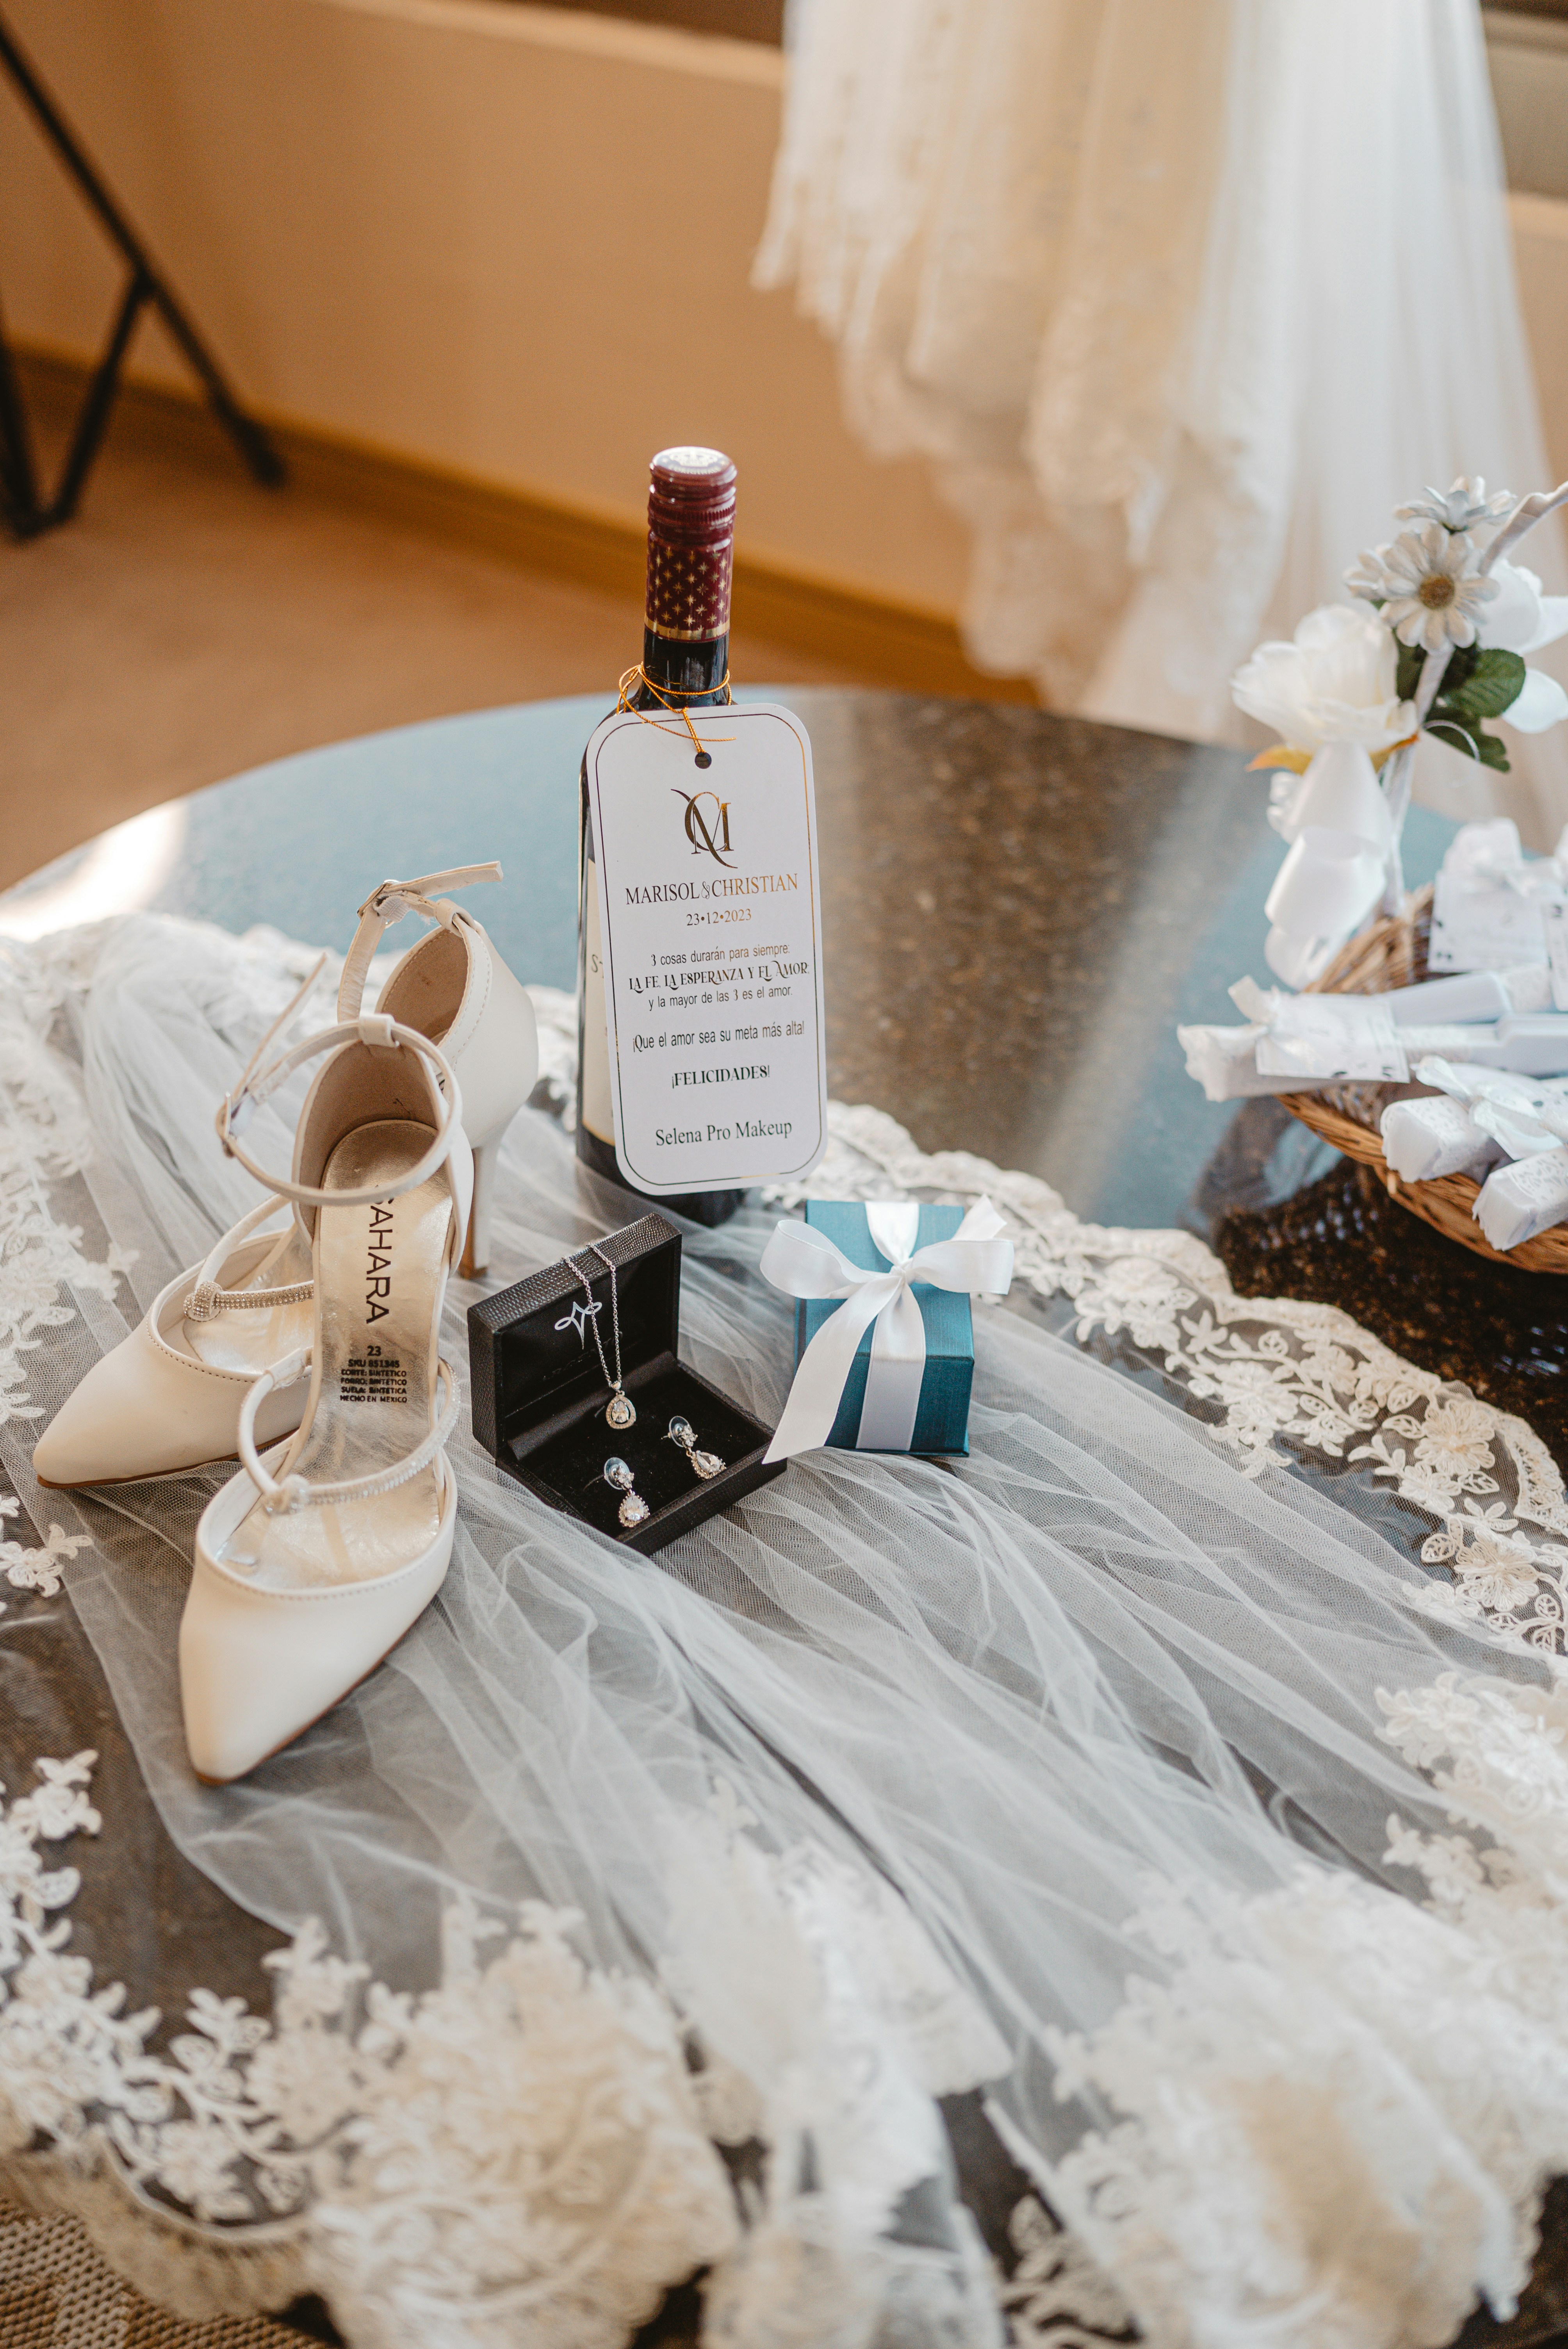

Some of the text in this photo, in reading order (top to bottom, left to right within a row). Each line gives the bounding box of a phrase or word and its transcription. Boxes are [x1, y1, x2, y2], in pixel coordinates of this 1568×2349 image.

[651, 943, 790, 966] 3 cosas durarán para siempre:
[629, 977, 645, 994] LA
[664, 975, 679, 991] LA
[681, 968, 744, 985] ESPERANZA
[748, 967, 754, 978] Y
[758, 966, 772, 982] EL
[649, 985, 793, 1011] y la mayor de las 3 es el amor.
[633, 1020, 805, 1053] ¡Que el amor sea su meta más alta!
[672, 1065, 770, 1089] ¡FELICIDADES!
[656, 1119, 792, 1146] Selena Pro Makeup
[365, 1184, 394, 1324] AHARA
[348, 1358, 366, 1367] SKU
[367, 1345, 381, 1356] 23
